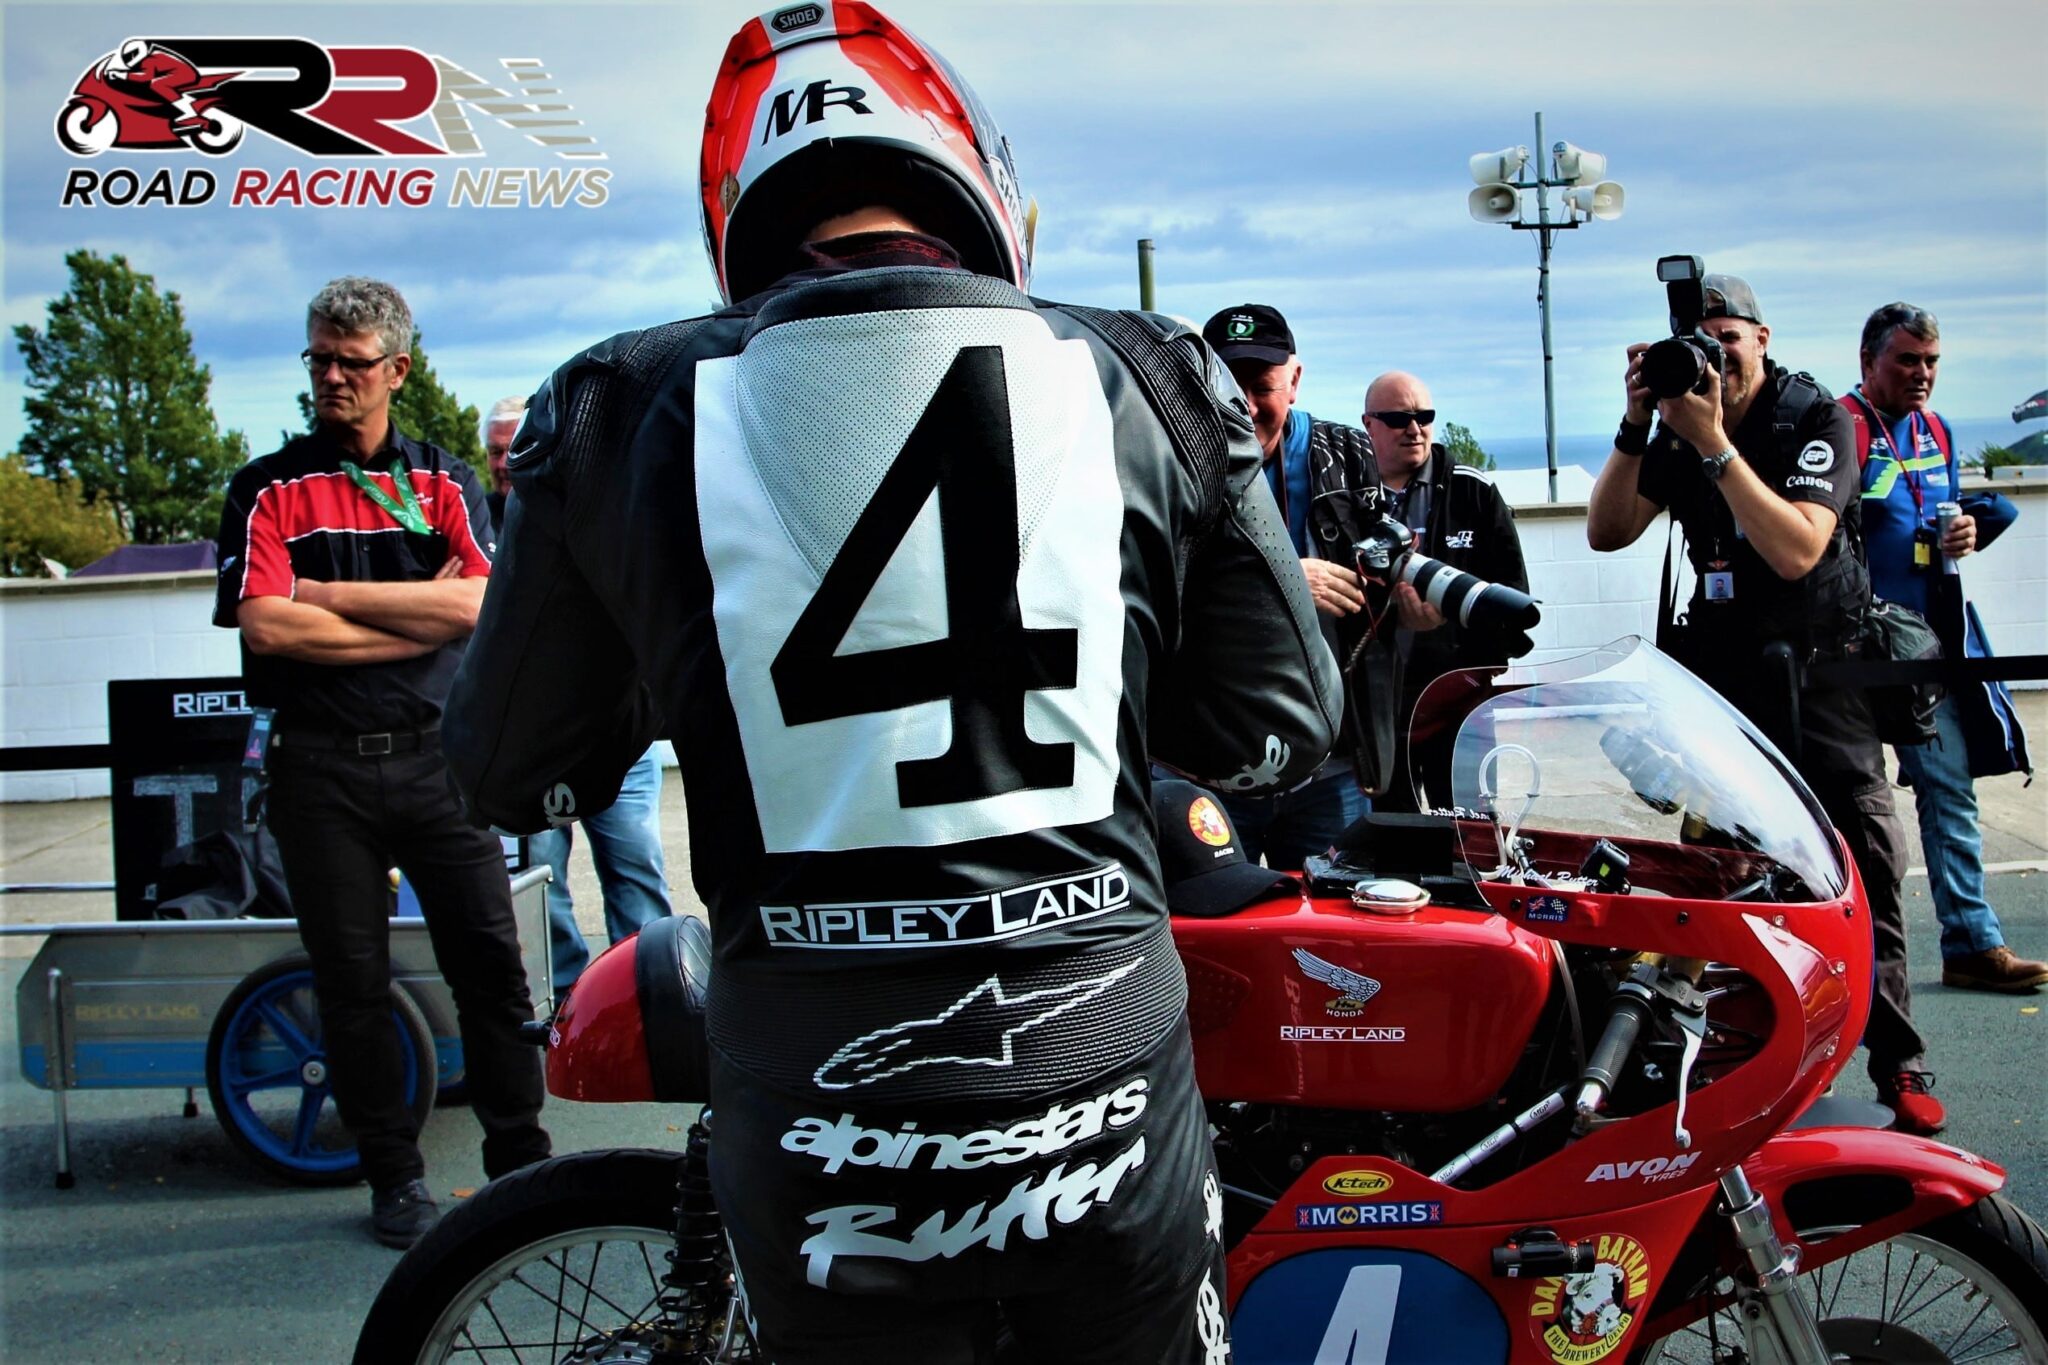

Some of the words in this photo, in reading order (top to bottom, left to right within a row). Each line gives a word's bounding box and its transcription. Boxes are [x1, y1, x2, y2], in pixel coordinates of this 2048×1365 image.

[779, 8, 817, 29] SHOEI
[761, 79, 874, 147] MR
[1786, 475, 1833, 493] Canon
[770, 345, 1078, 808] 4
[1556, 872, 1599, 887] Rutter
[760, 903, 970, 944] RIPLEY
[991, 869, 1130, 935] LAND
[1528, 912, 1564, 922] MORRIS
[1326, 1008, 1365, 1018] HONDA
[1280, 1026, 1346, 1039] RIPLEY
[1353, 1026, 1405, 1039] LAND
[780, 1078, 1149, 1174] alpinestars
[1585, 1151, 1702, 1182] AVON
[1643, 1168, 1688, 1184] TYRES
[800, 1135, 1146, 1289] Rutter
[1312, 1204, 1428, 1225] MORRIS
[1597, 1235, 1648, 1299] BATHAM
[1547, 1329, 1567, 1348] THE
[1563, 1342, 1607, 1361] BREWERY
[1607, 1315, 1630, 1342] DELPH
